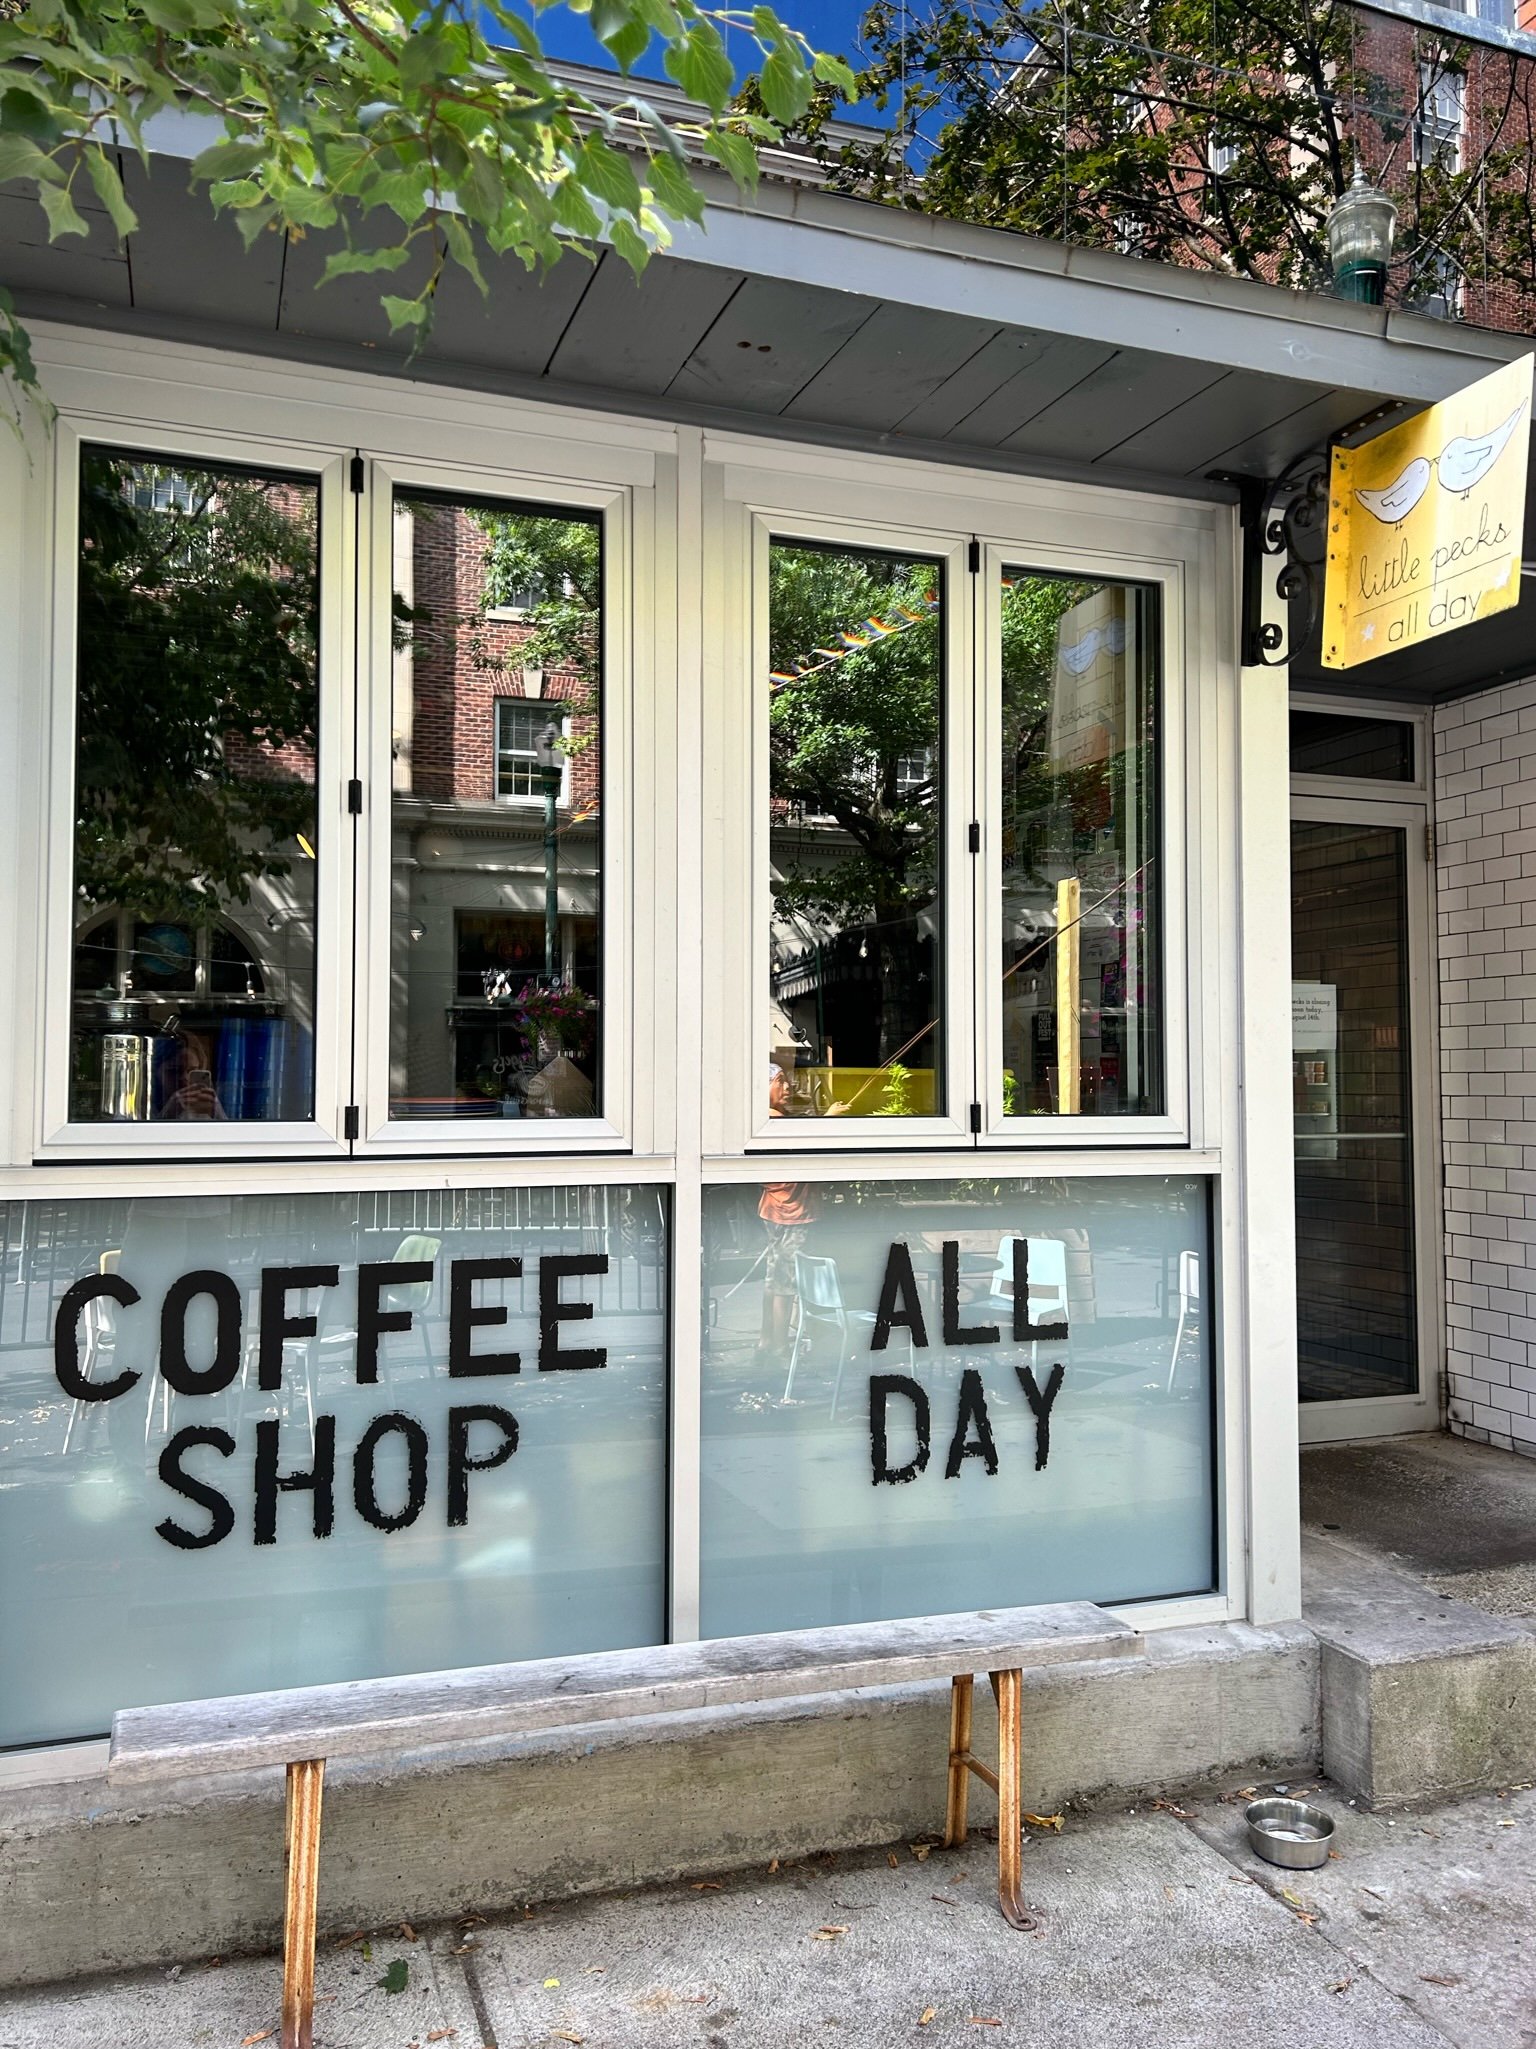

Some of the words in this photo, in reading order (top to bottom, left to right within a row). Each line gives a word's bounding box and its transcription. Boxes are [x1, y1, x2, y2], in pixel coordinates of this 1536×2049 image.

[1357, 537, 1420, 600] little
[1430, 503, 1512, 592] pecks
[1387, 601, 1419, 642] all
[1428, 588, 1483, 628] day
[1038, 1012, 1051, 1021] FULL
[1038, 1020, 1052, 1029] OUT
[1038, 1029, 1051, 1037] FEST
[54, 1252, 609, 1402] COFFEE
[869, 1238, 1069, 1350] ALL
[870, 1363, 1066, 1486] DAY
[154, 1404, 520, 1550] SHOP
